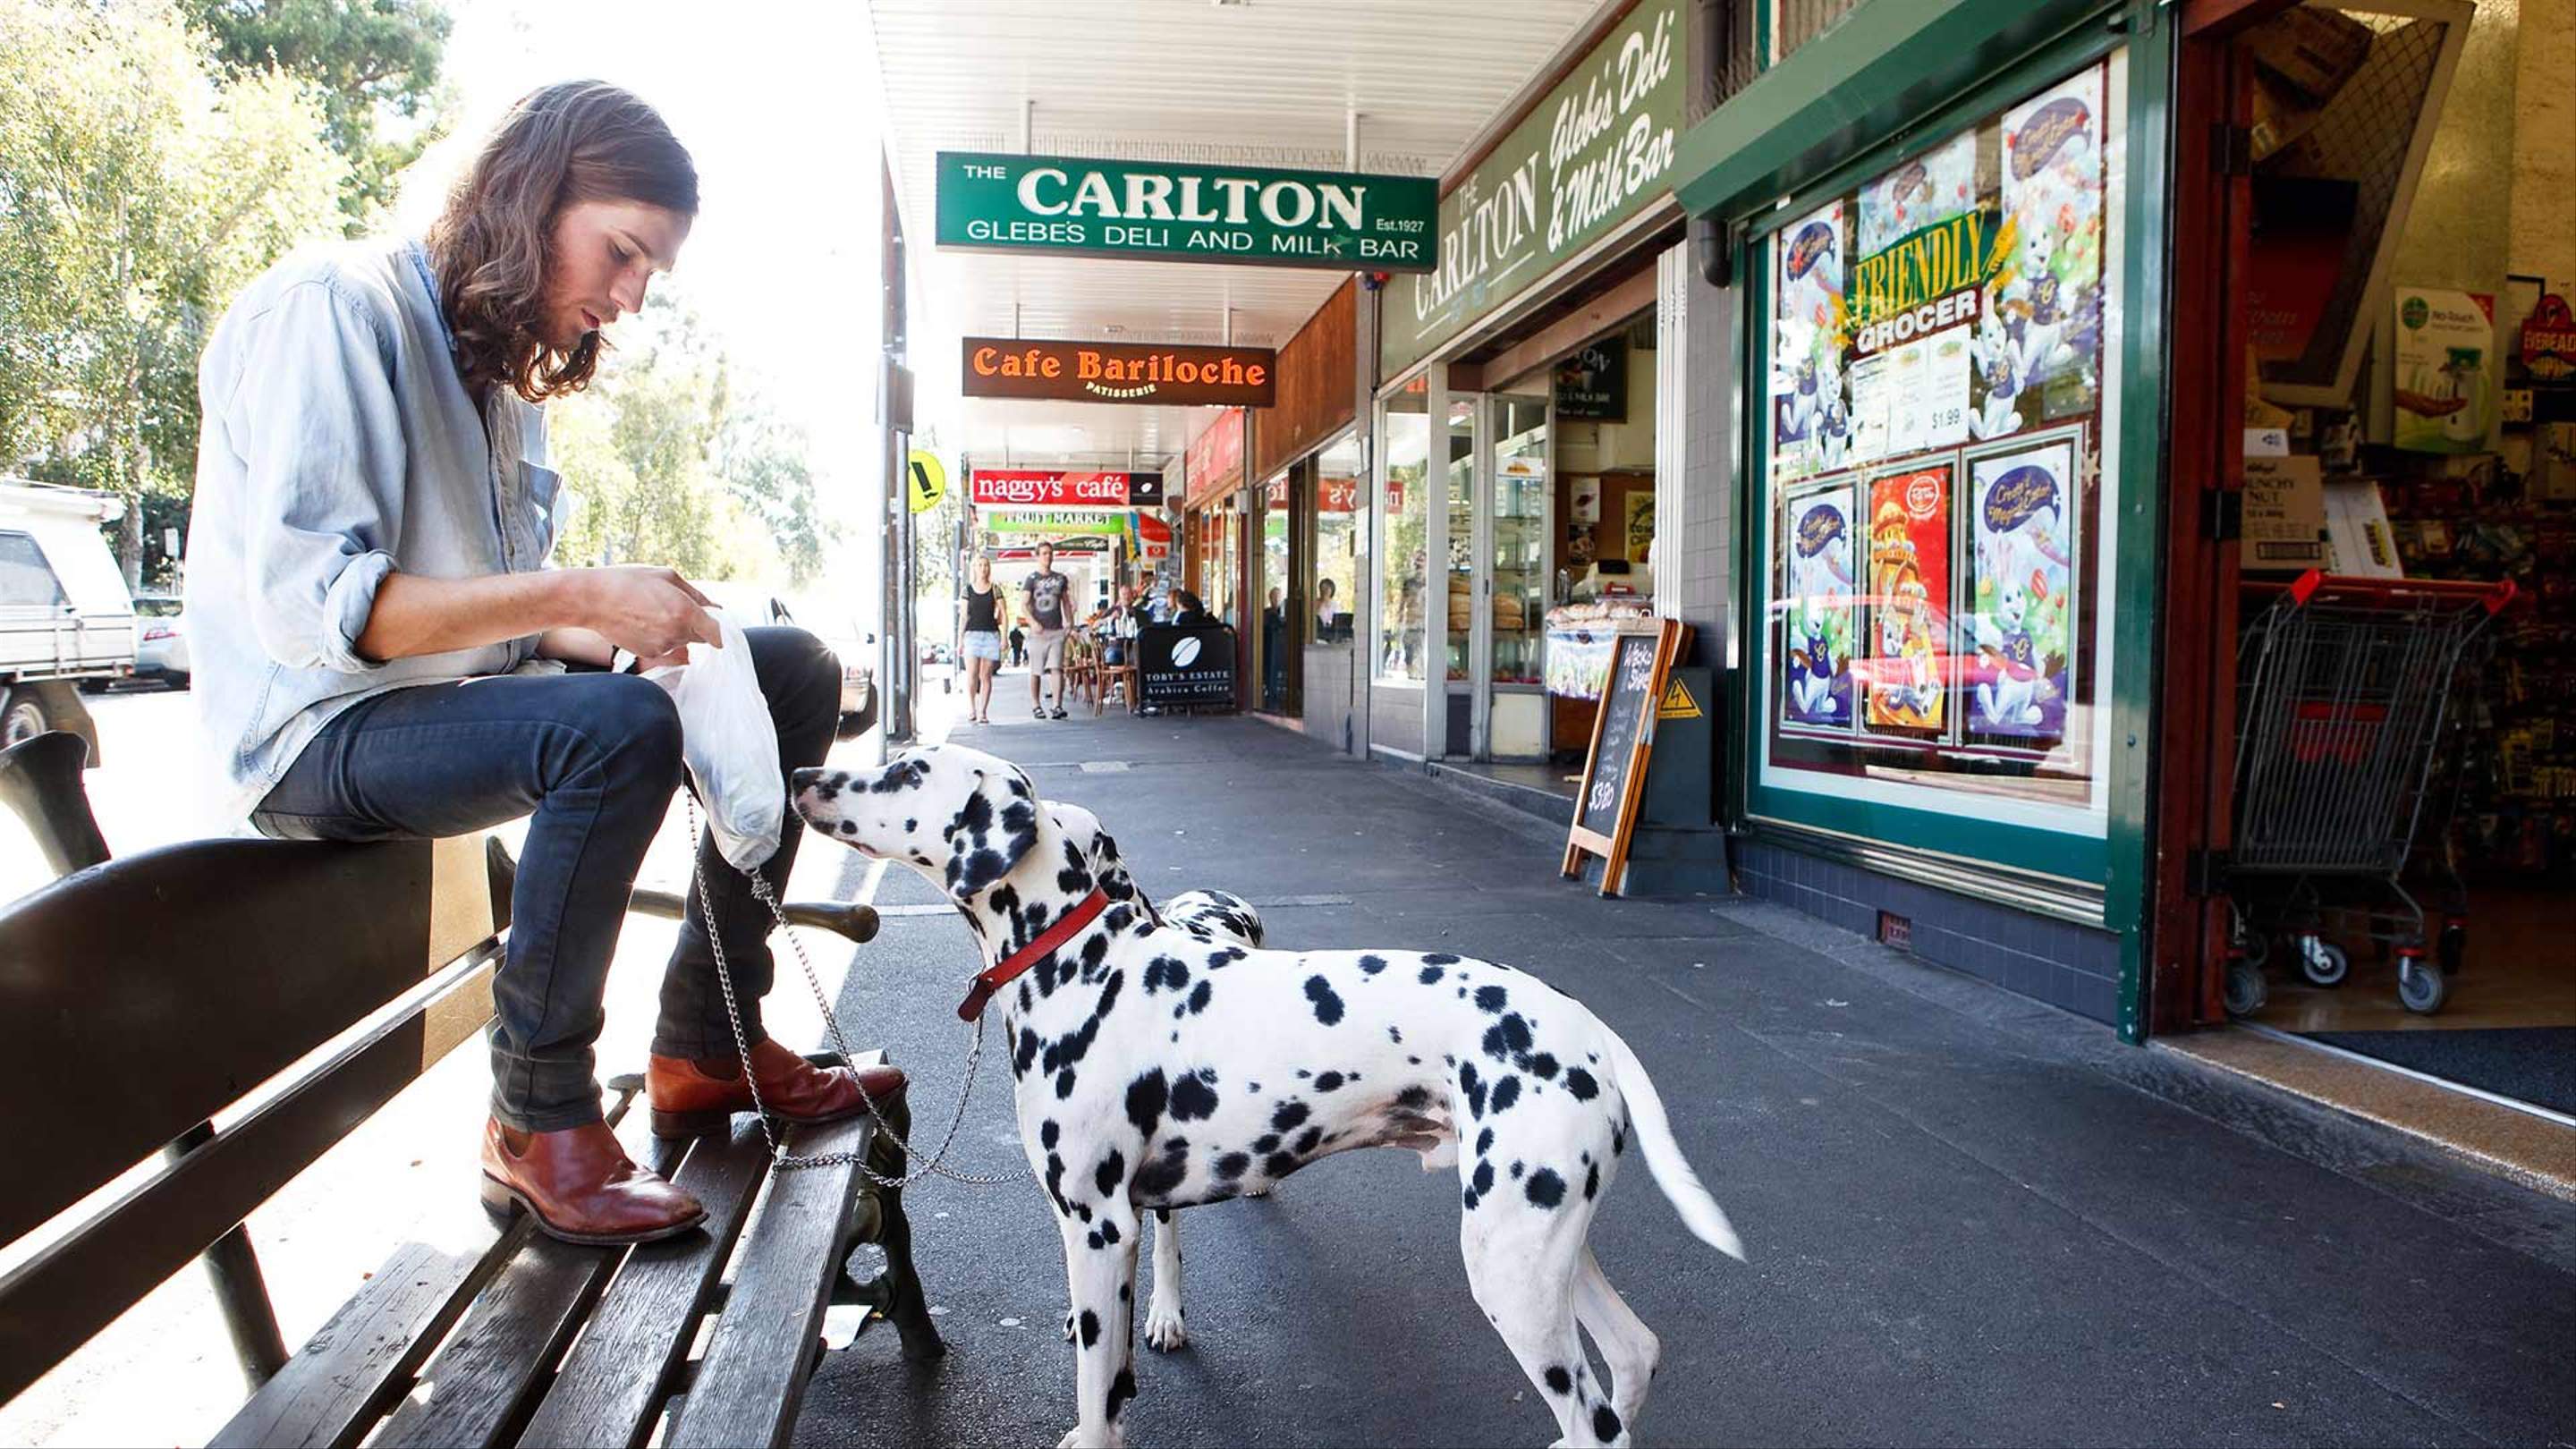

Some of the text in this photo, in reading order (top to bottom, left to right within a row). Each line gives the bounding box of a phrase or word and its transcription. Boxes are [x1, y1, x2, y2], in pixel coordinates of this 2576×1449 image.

[1618, 10, 1674, 114] Deli
[963, 165, 1006, 180] THE
[1547, 112, 1674, 253] & Milk Bar
[1017, 167, 1367, 231] CARLTON
[1458, 174, 1479, 217] THE
[967, 220, 1419, 259] GLEBE'S DELI AND MILK BAR
[1376, 218, 1425, 233] Est.1927
[1415, 151, 1540, 321] CARLTON
[1852, 208, 1986, 327] FRIENDLY
[1858, 290, 1978, 352] GROCER
[973, 347, 1266, 386] Cafe Bariloche
[1086, 381, 1157, 398] PATISSERIE
[1931, 406, 1961, 431] $1.99
[978, 475, 1123, 501] naggy's café
[1005, 512, 1111, 525] FRUIT MARKET
[1190, 670, 1230, 680] ESTATE
